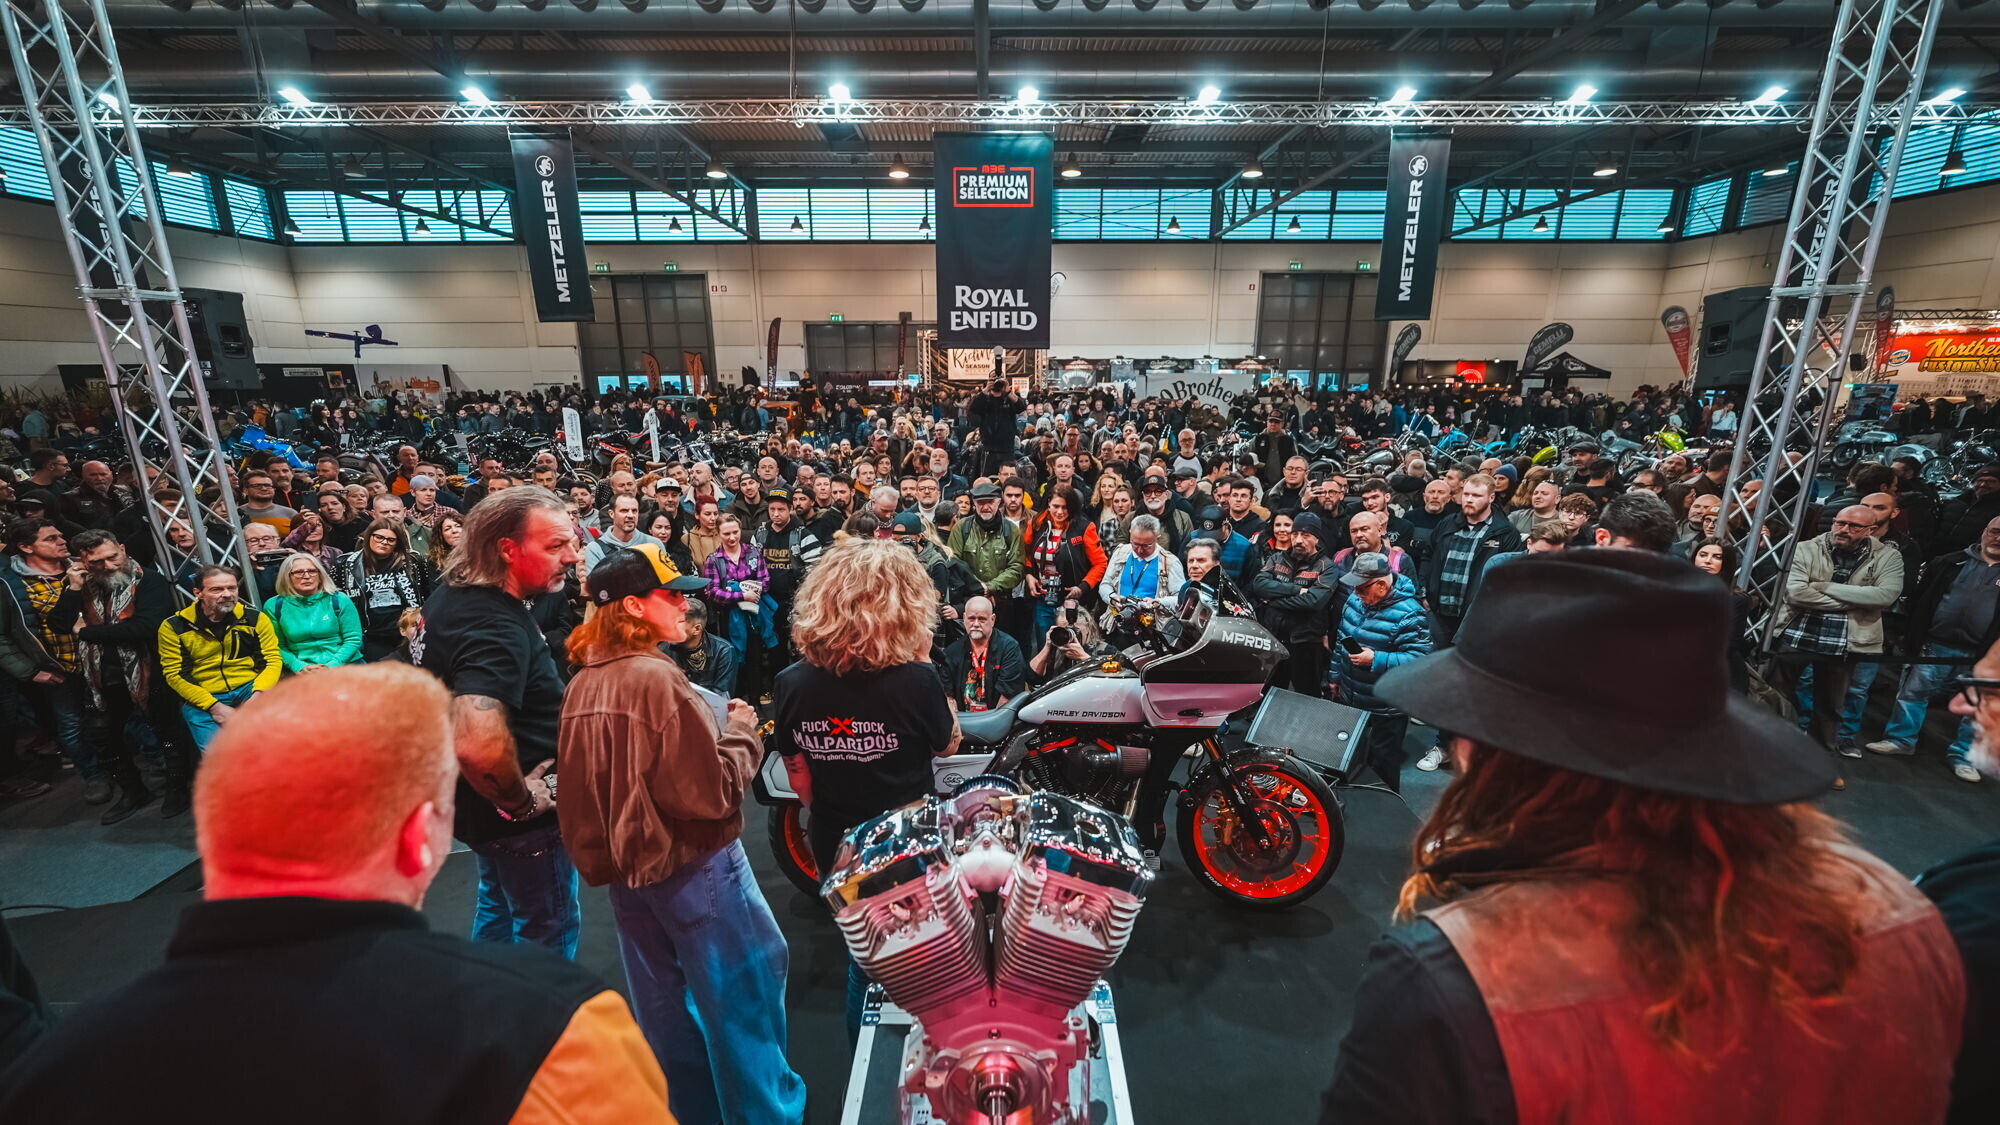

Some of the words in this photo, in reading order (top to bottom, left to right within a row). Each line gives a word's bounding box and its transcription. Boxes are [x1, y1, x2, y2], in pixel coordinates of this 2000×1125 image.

[959, 175, 1028, 188] PREMIUM
[959, 188, 1029, 200] SELECTION
[541, 179, 571, 303] METZELER
[1397, 179, 1424, 302] METZELER
[955, 285, 1029, 310] ROYAL
[950, 311, 1038, 331] ENFIELD
[1046, 709, 1080, 718] HARLEY
[1081, 711, 1126, 719] DAVIDSON
[801, 720, 831, 733] FUCK
[851, 721, 886, 735] STOCK
